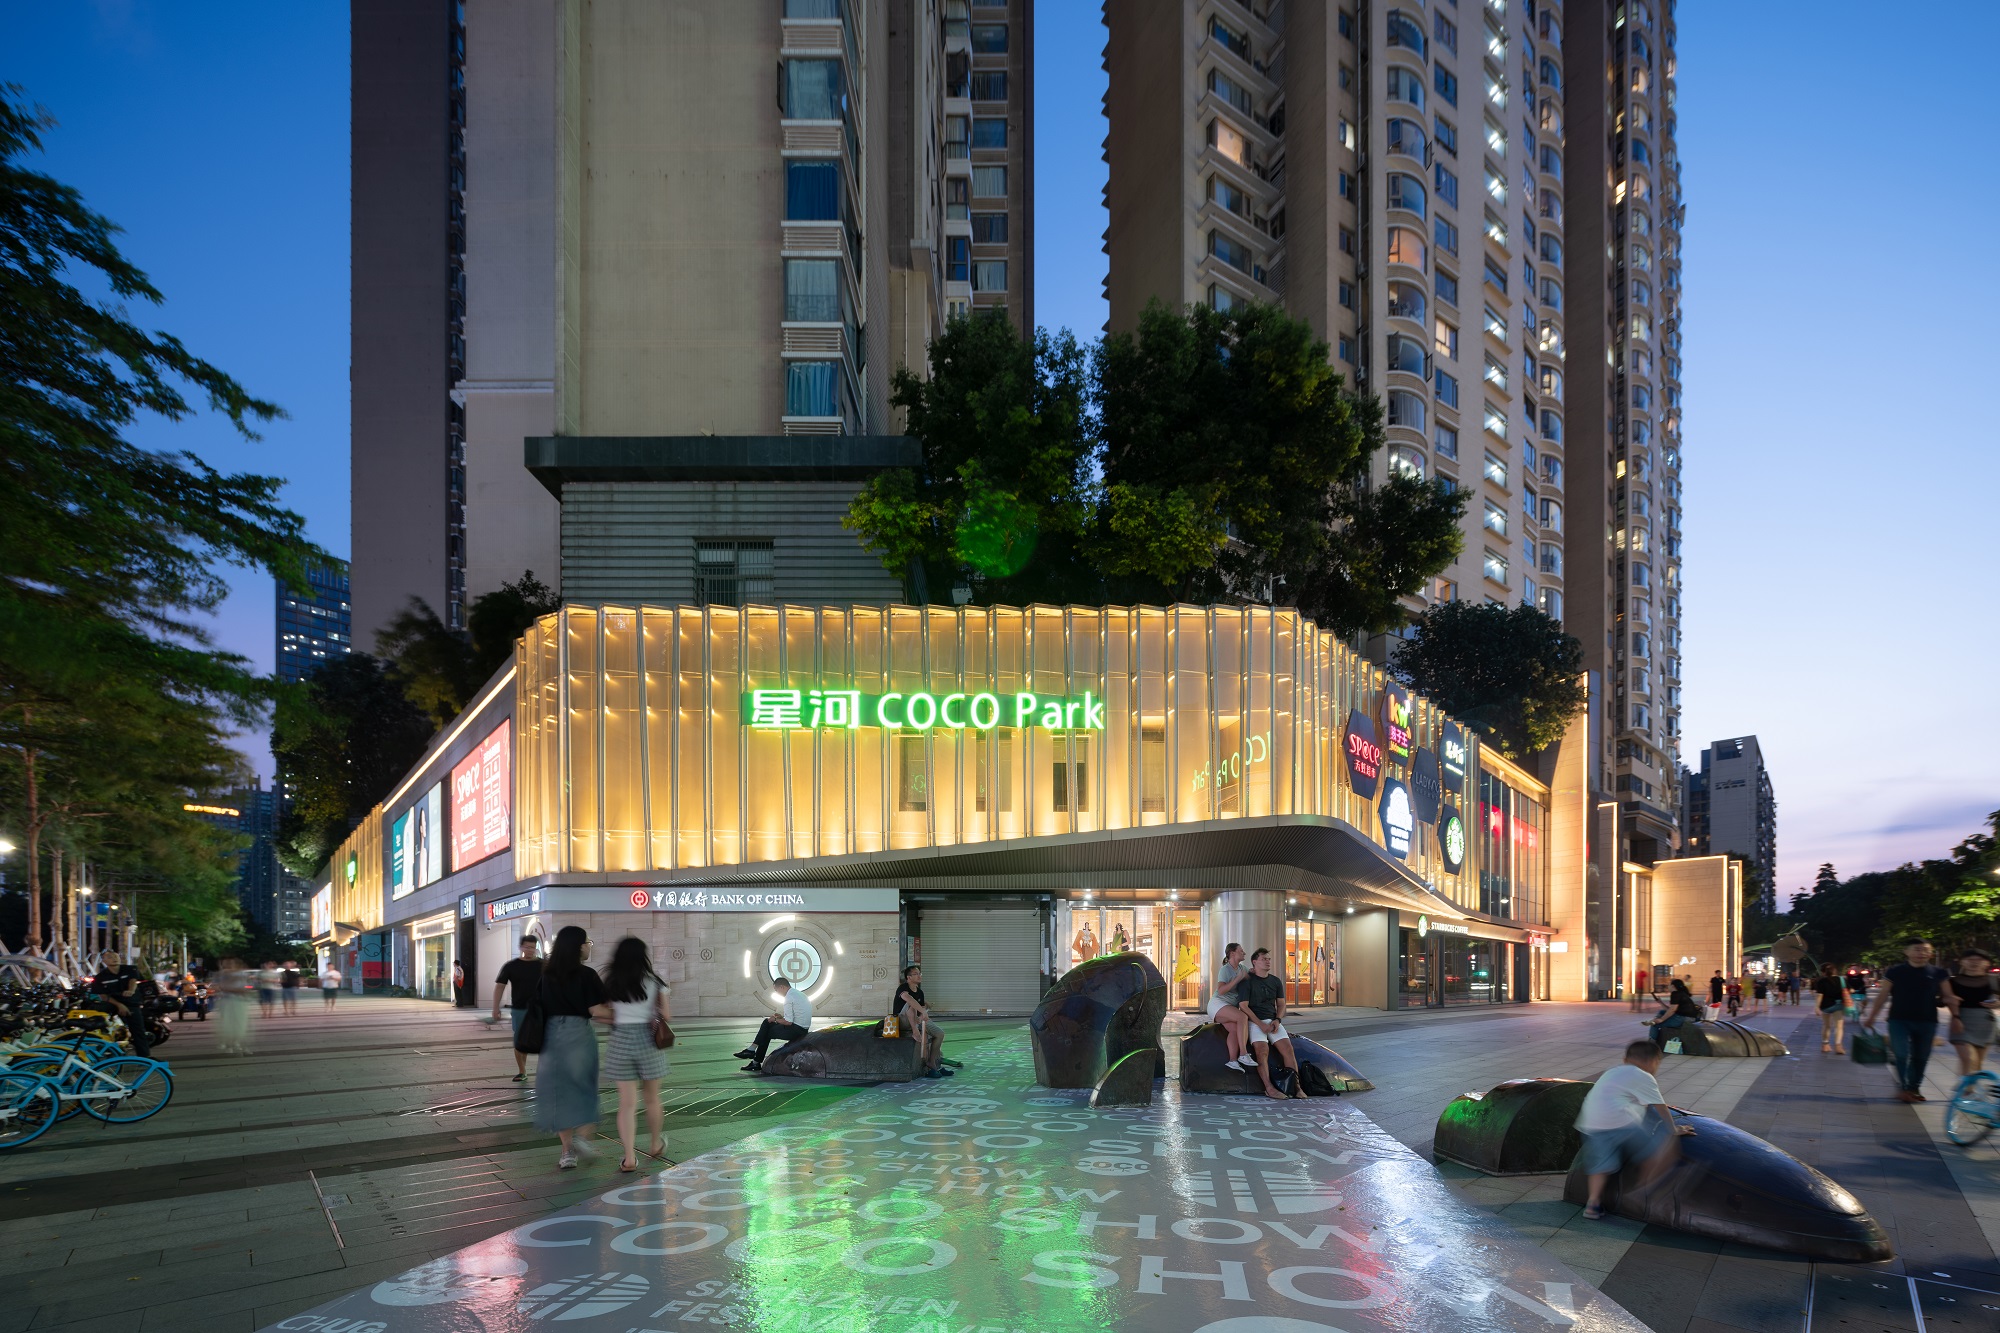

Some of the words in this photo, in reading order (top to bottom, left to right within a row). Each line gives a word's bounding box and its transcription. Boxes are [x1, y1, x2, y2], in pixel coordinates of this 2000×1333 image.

[752, 689, 860, 729] 星河
[877, 692, 1000, 729] COCO
[1016, 690, 1105, 729] Park
[653, 891, 708, 908] 中国银行
[711, 894, 745, 905] BANK
[747, 894, 762, 905] OF
[765, 894, 804, 905] CHINA
[855, 1115, 1089, 1132] COCO
[762, 1127, 1044, 1149] COCO
[867, 1151, 1008, 1163] SHOW
[872, 1162, 1047, 1180] SHOW
[892, 1178, 1122, 1204] SHOW
[991, 1207, 1390, 1252] SHOW
[514, 1215, 958, 1276] COCO
